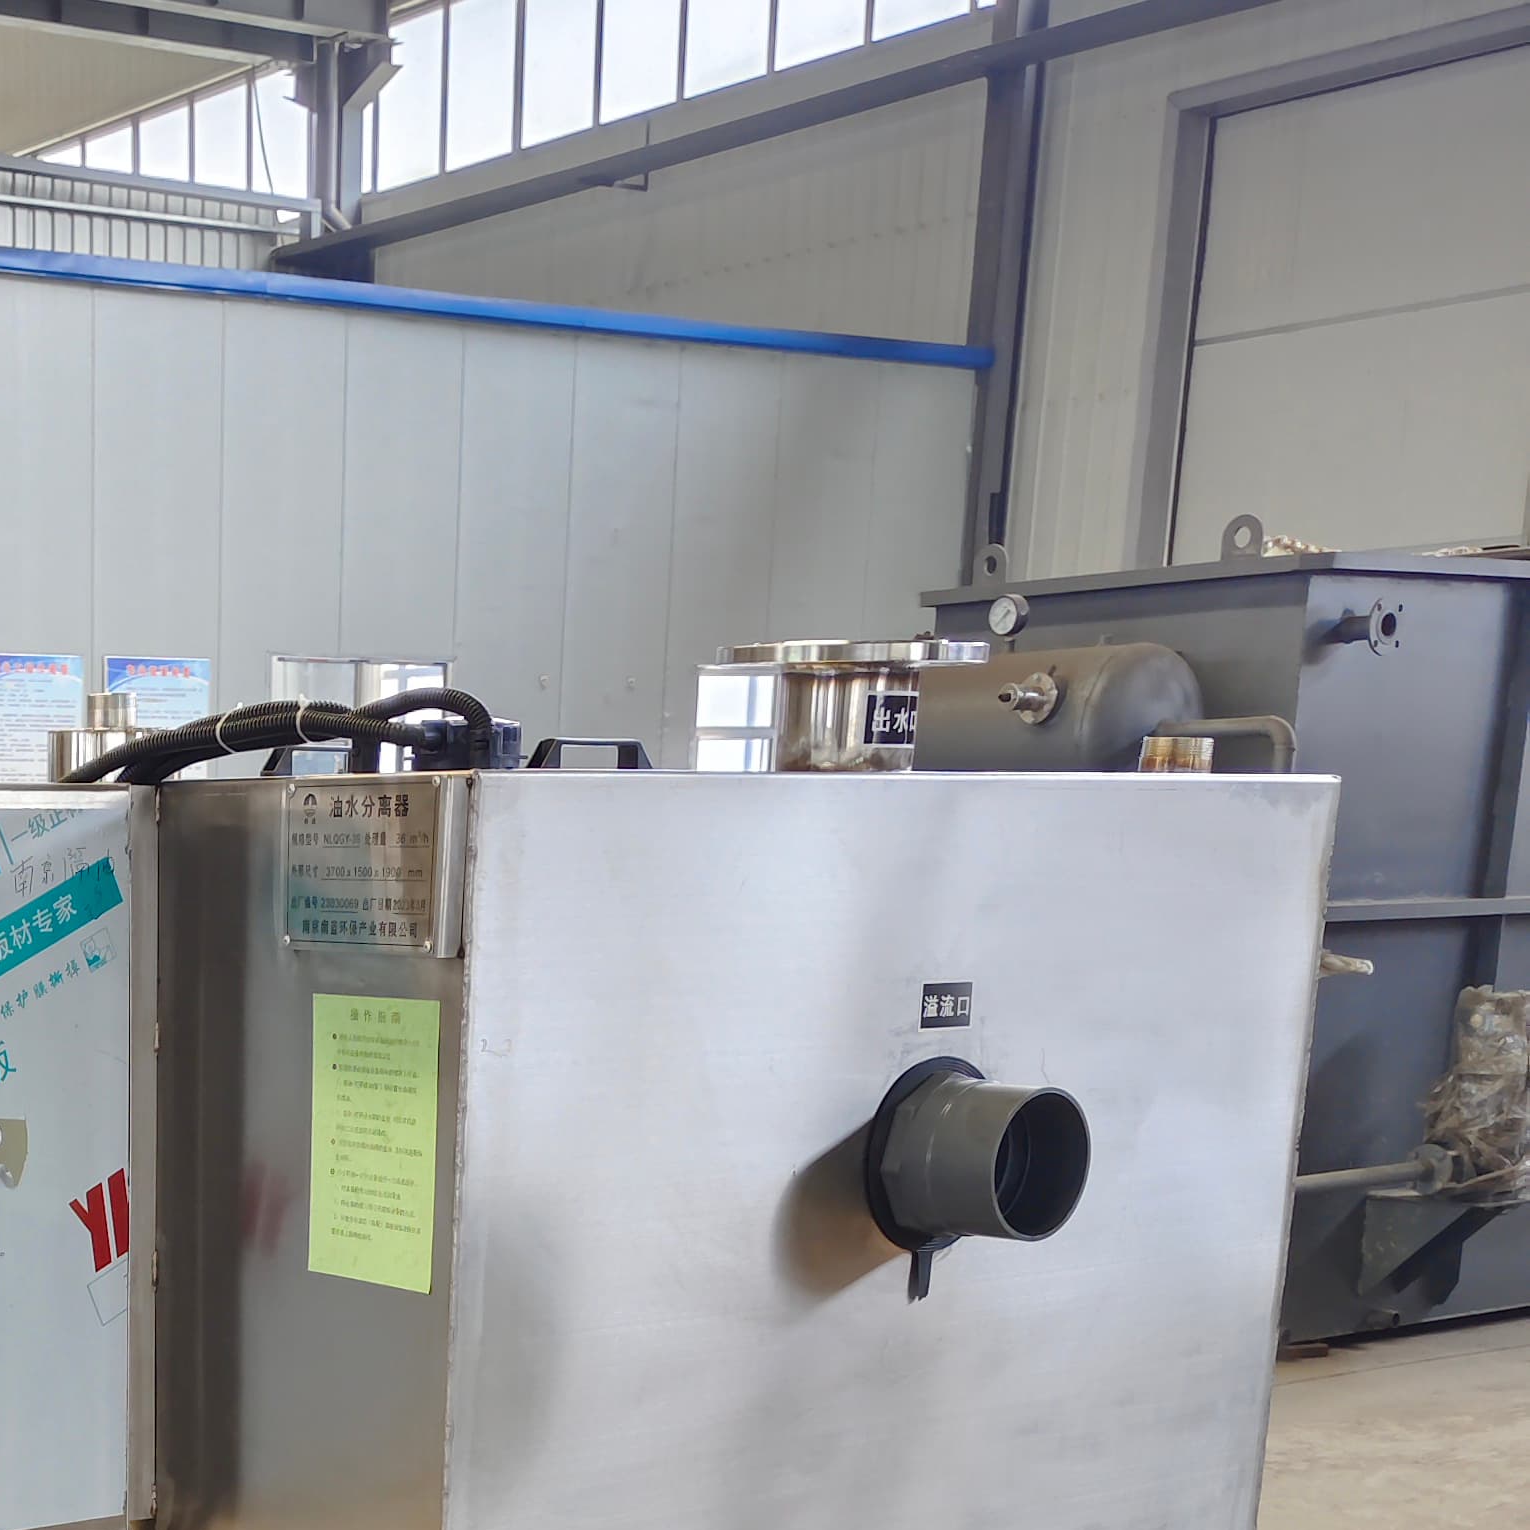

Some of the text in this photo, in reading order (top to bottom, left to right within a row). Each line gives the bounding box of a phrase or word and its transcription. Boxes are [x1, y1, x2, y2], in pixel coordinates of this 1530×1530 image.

[329, 794, 410, 818] 油水分离器
[923, 995, 970, 1017] 溢流口
